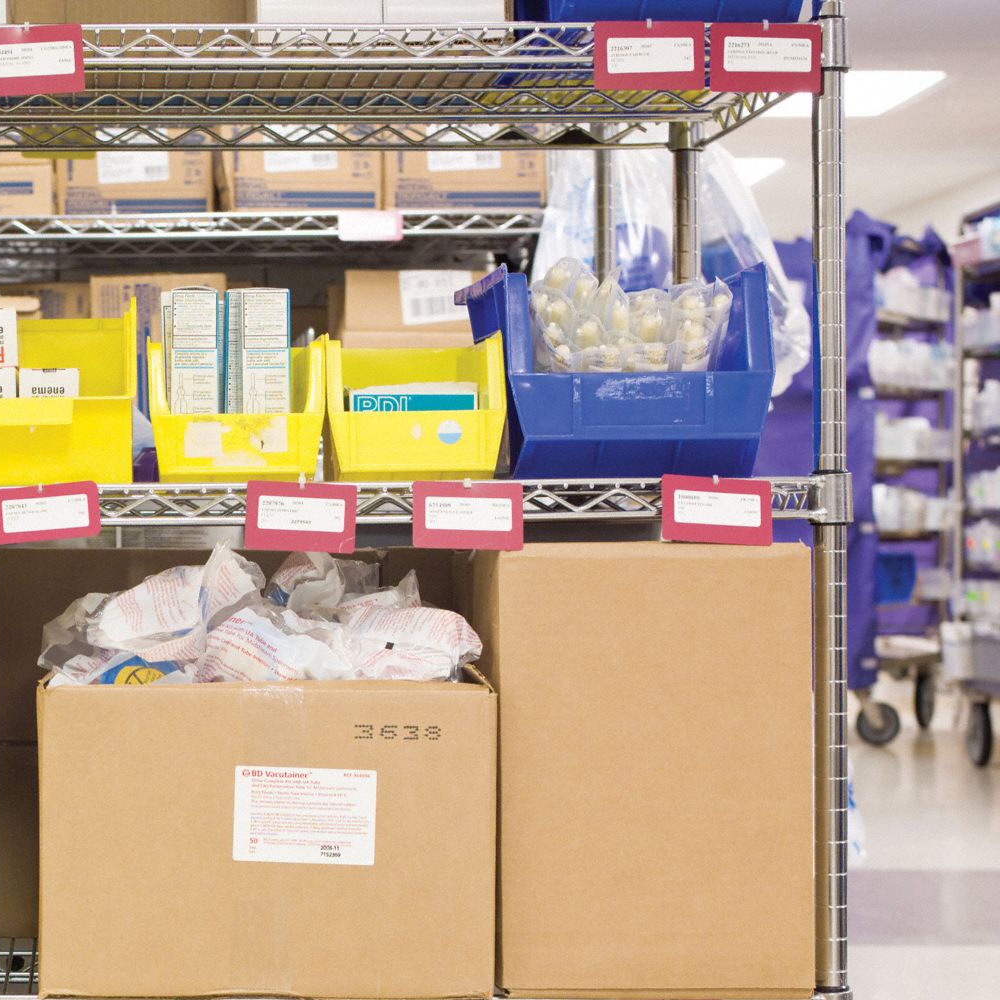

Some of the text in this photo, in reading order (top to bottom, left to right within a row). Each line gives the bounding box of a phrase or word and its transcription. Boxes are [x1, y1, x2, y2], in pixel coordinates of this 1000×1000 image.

[32, 386, 65, 394] enema
[354, 724, 442, 741] 3638
[251, 769, 263, 778] BD
